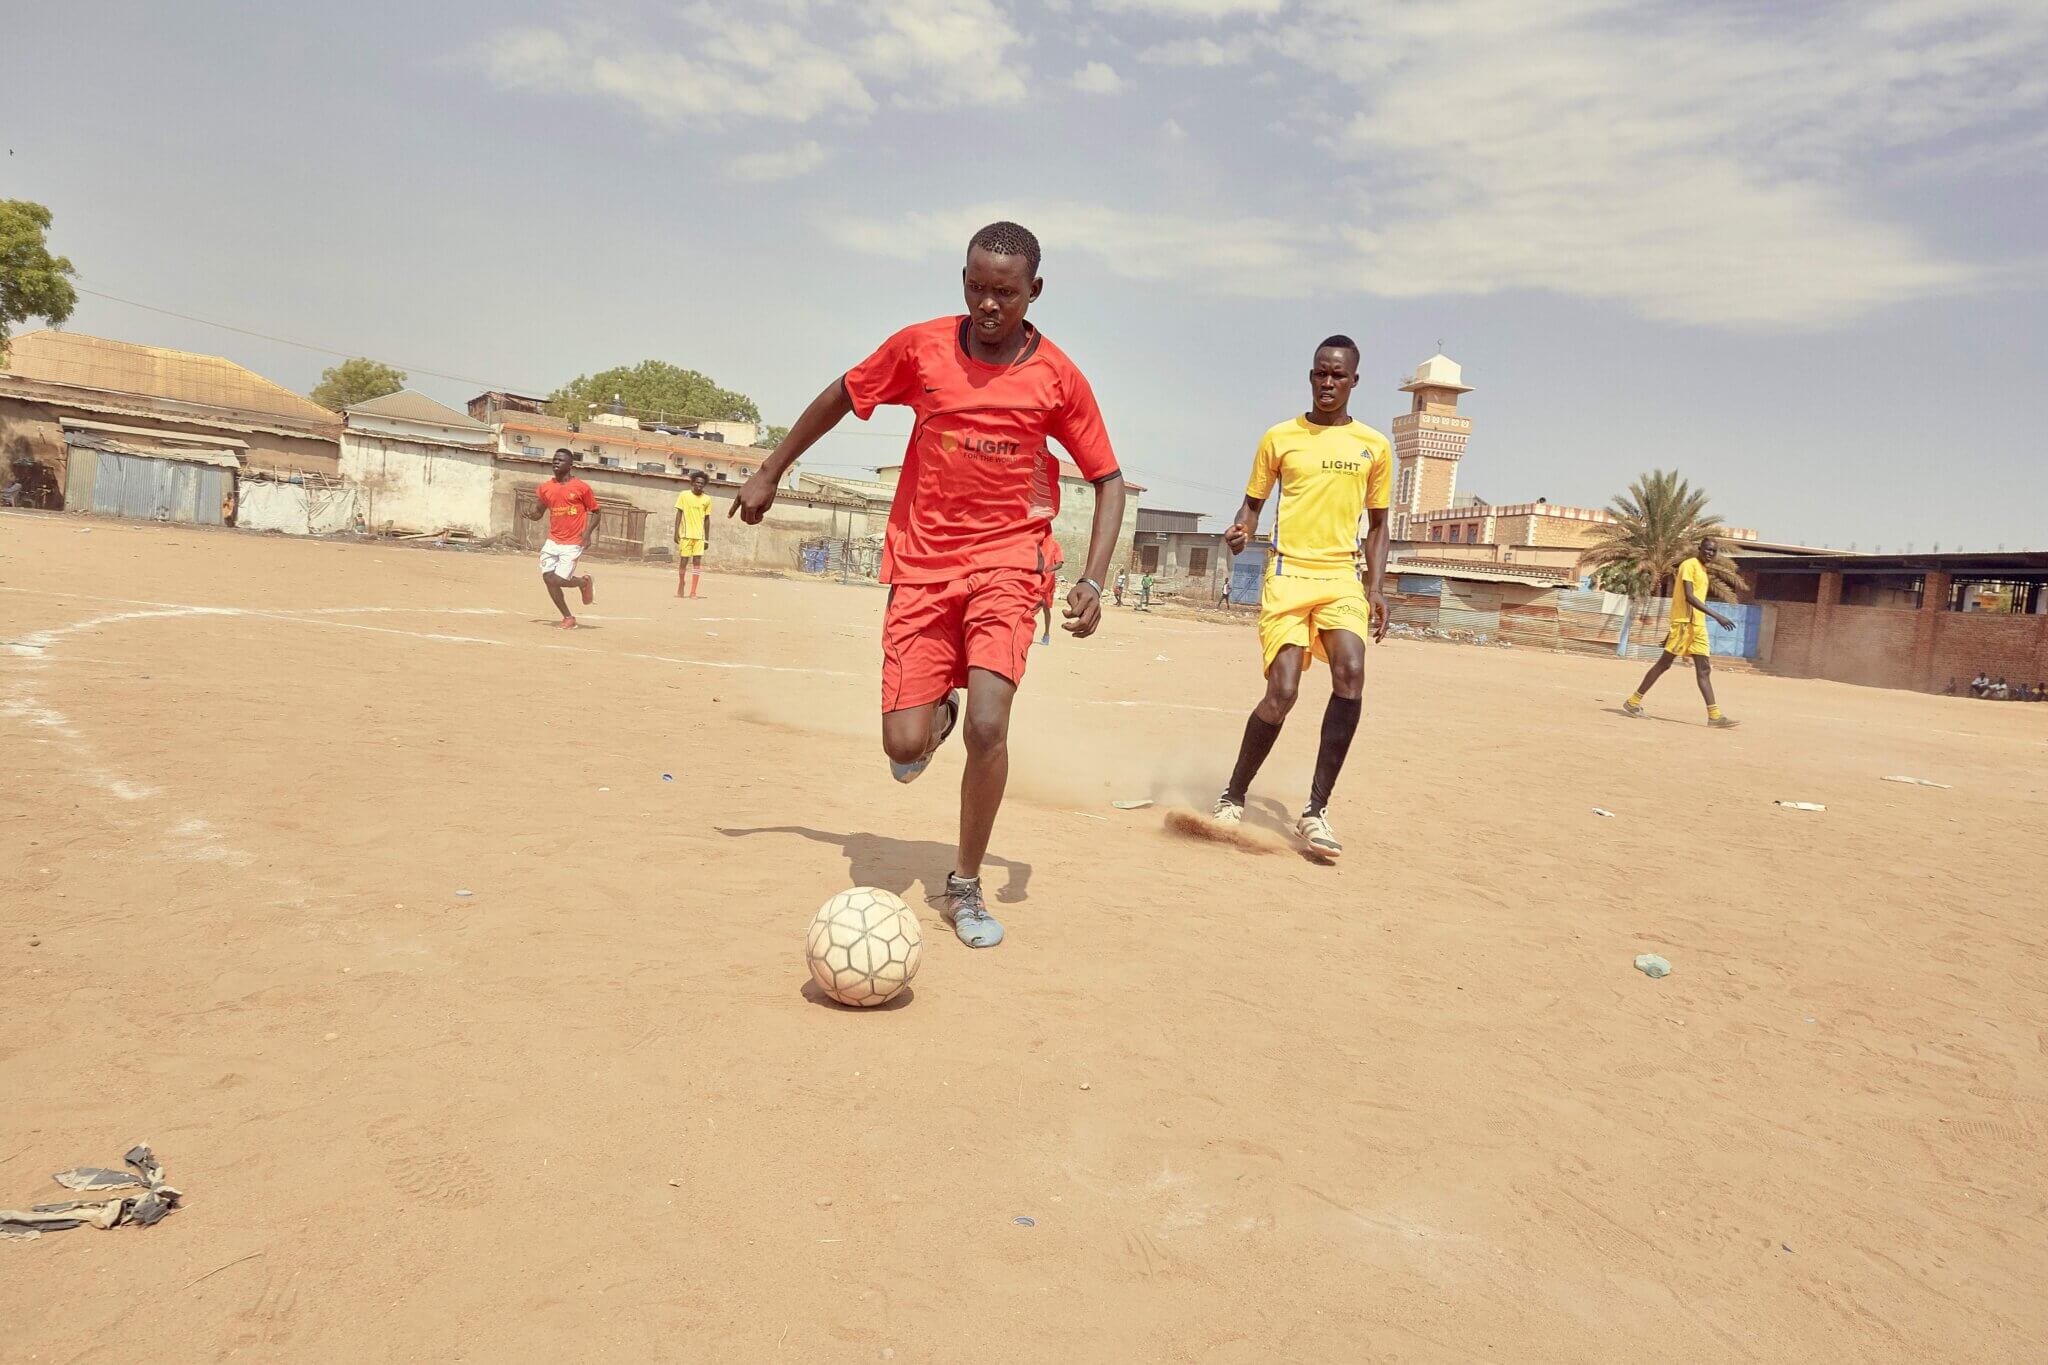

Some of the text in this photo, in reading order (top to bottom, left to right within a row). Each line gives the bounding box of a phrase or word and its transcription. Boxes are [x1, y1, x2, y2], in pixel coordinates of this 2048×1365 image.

[965, 437, 1020, 455] LIGHT
[963, 452, 978, 460] FOR
[980, 454, 994, 462] THE
[1322, 460, 1361, 471] LIGHT
